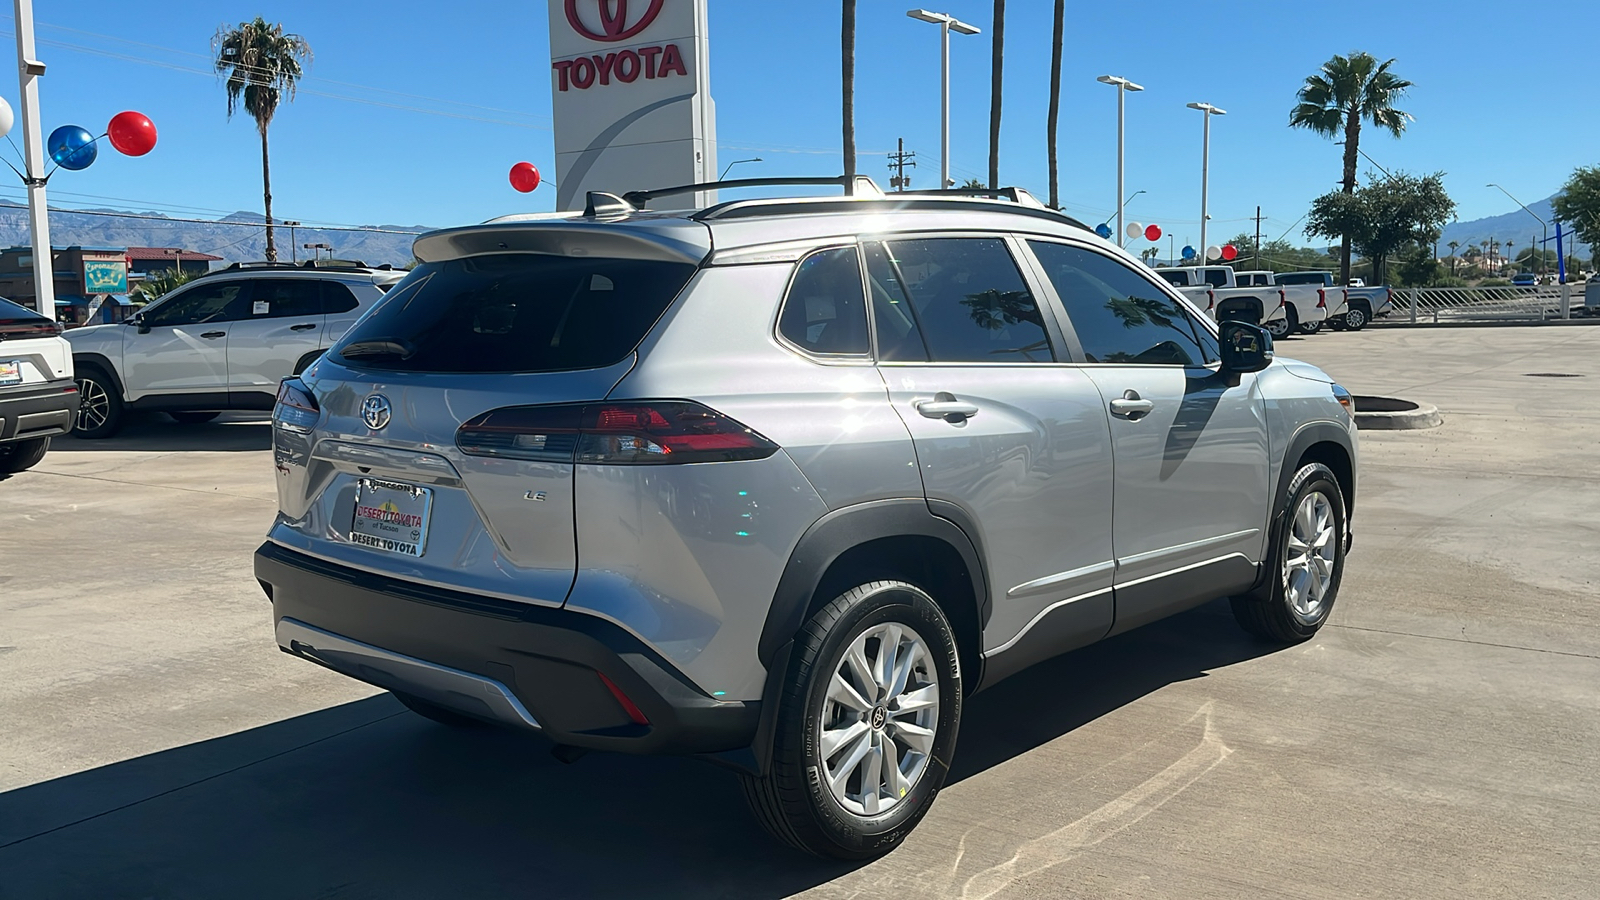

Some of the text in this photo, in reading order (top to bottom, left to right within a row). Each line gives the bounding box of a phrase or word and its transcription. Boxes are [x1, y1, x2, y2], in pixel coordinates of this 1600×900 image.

[553, 44, 687, 92] TOYOTA
[523, 490, 547, 501] LE
[357, 506, 422, 528] DESERT TOYOTA
[379, 522, 399, 533] Tucson
[352, 533, 417, 555] DESERT TOYOTA
